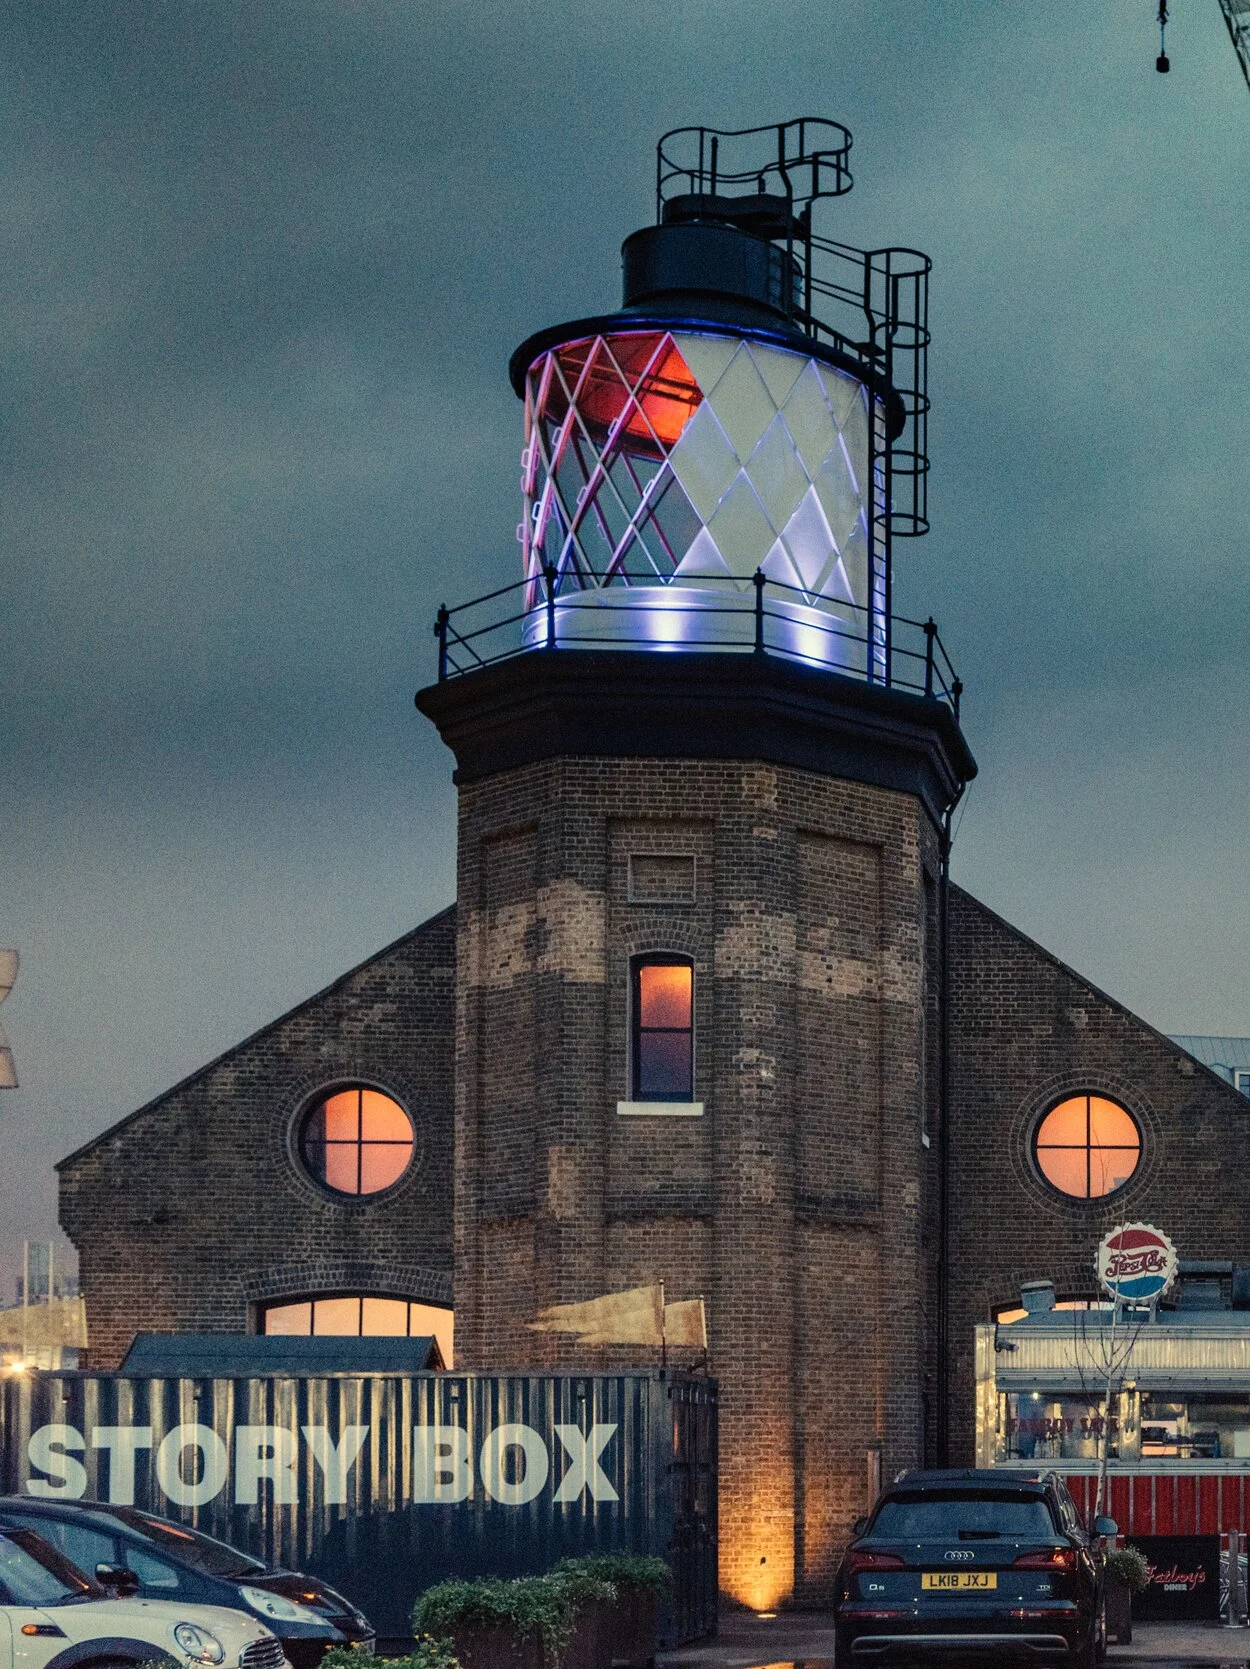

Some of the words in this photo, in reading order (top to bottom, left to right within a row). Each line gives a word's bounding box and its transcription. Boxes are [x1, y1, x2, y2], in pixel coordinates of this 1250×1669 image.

[26, 1423, 370, 1506] STORY
[413, 1423, 620, 1504] BOX
[963, 1575, 989, 1587] JXJ
[1144, 1564, 1206, 1590] Fatboy's
[1164, 1583, 1187, 1591] DINER
